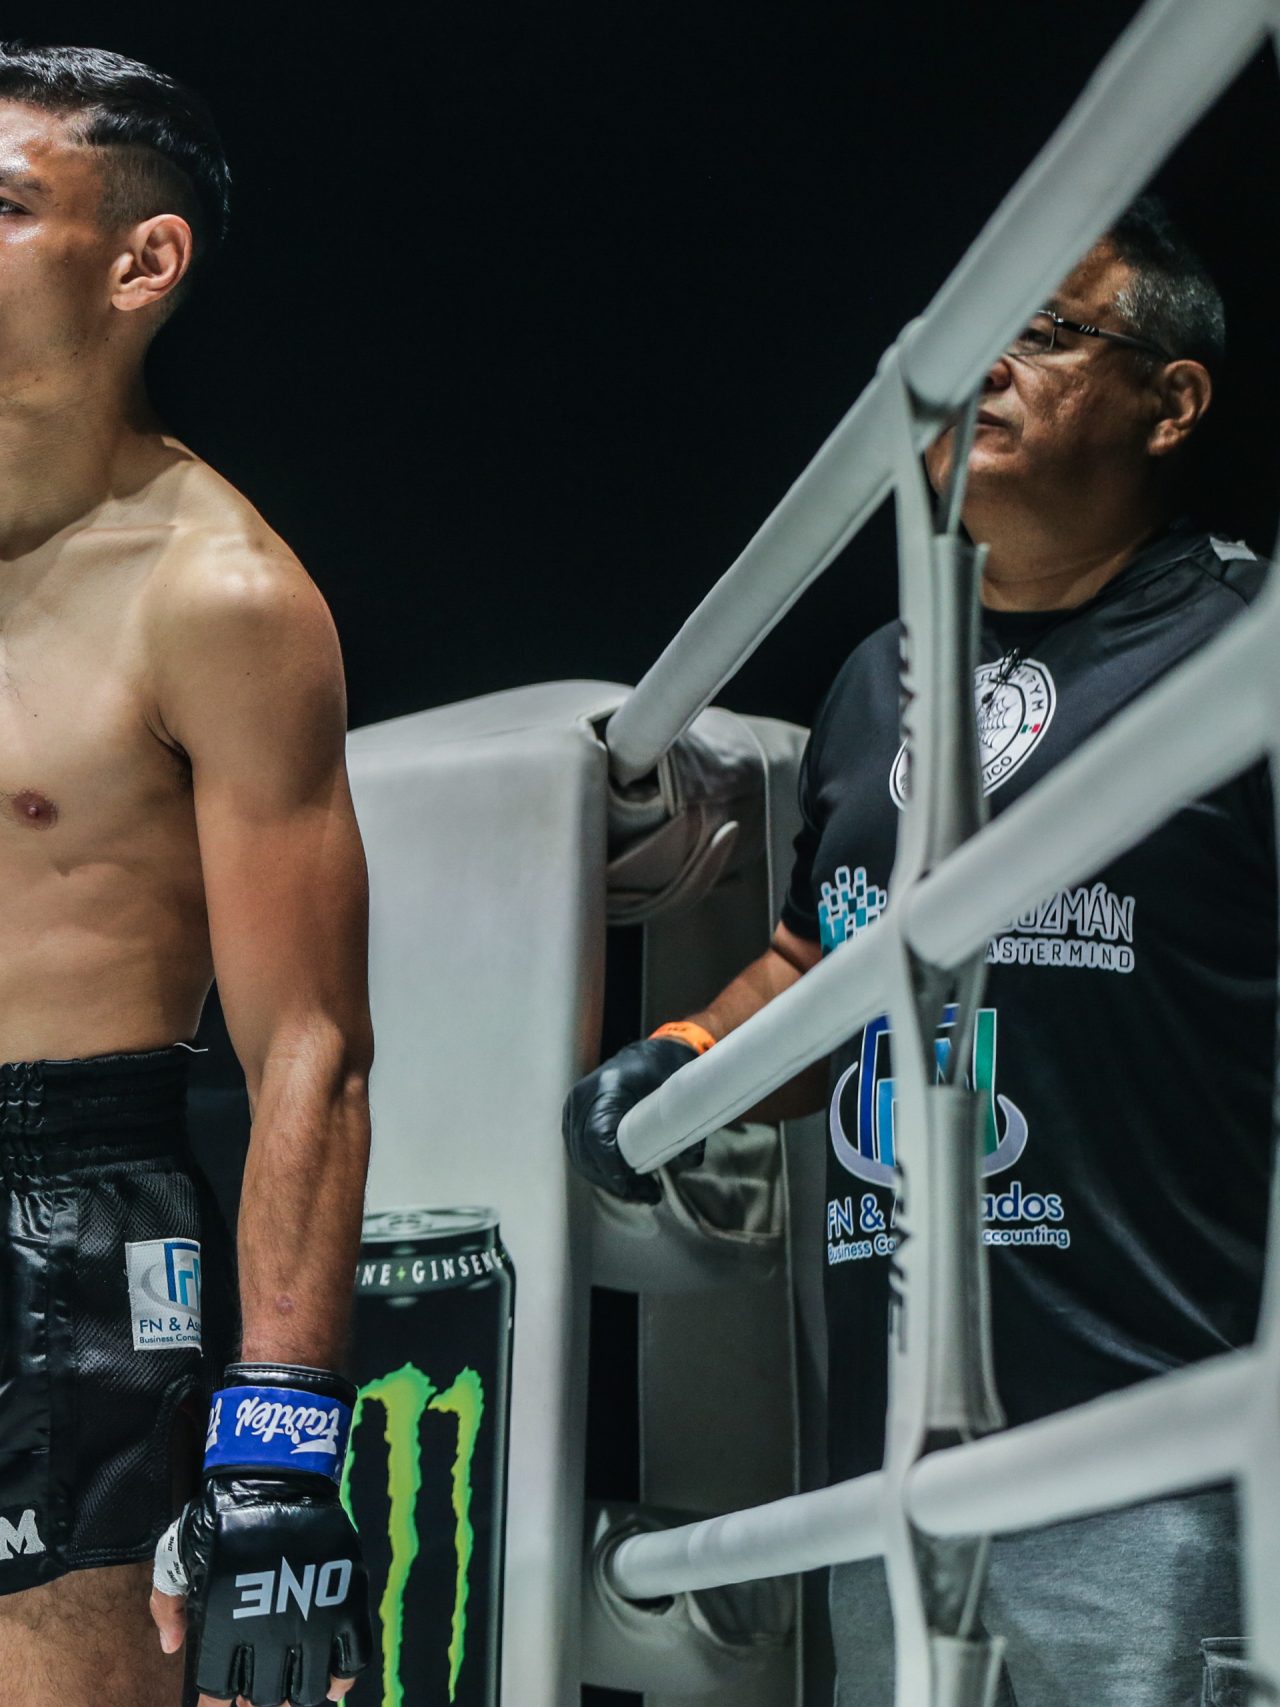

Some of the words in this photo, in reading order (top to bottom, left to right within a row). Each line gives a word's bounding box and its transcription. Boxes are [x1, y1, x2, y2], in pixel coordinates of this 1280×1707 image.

[828, 1196, 853, 1240] FN
[860, 1193, 886, 1232] &
[982, 1224, 1070, 1249] ccounting
[412, 1248, 503, 1285] GINSENG
[139, 1318, 163, 1334] FN
[169, 1316, 182, 1331] &
[139, 1335, 174, 1344] Business
[235, 1397, 340, 1454] Fairtex
[233, 1556, 353, 1621] ONE
